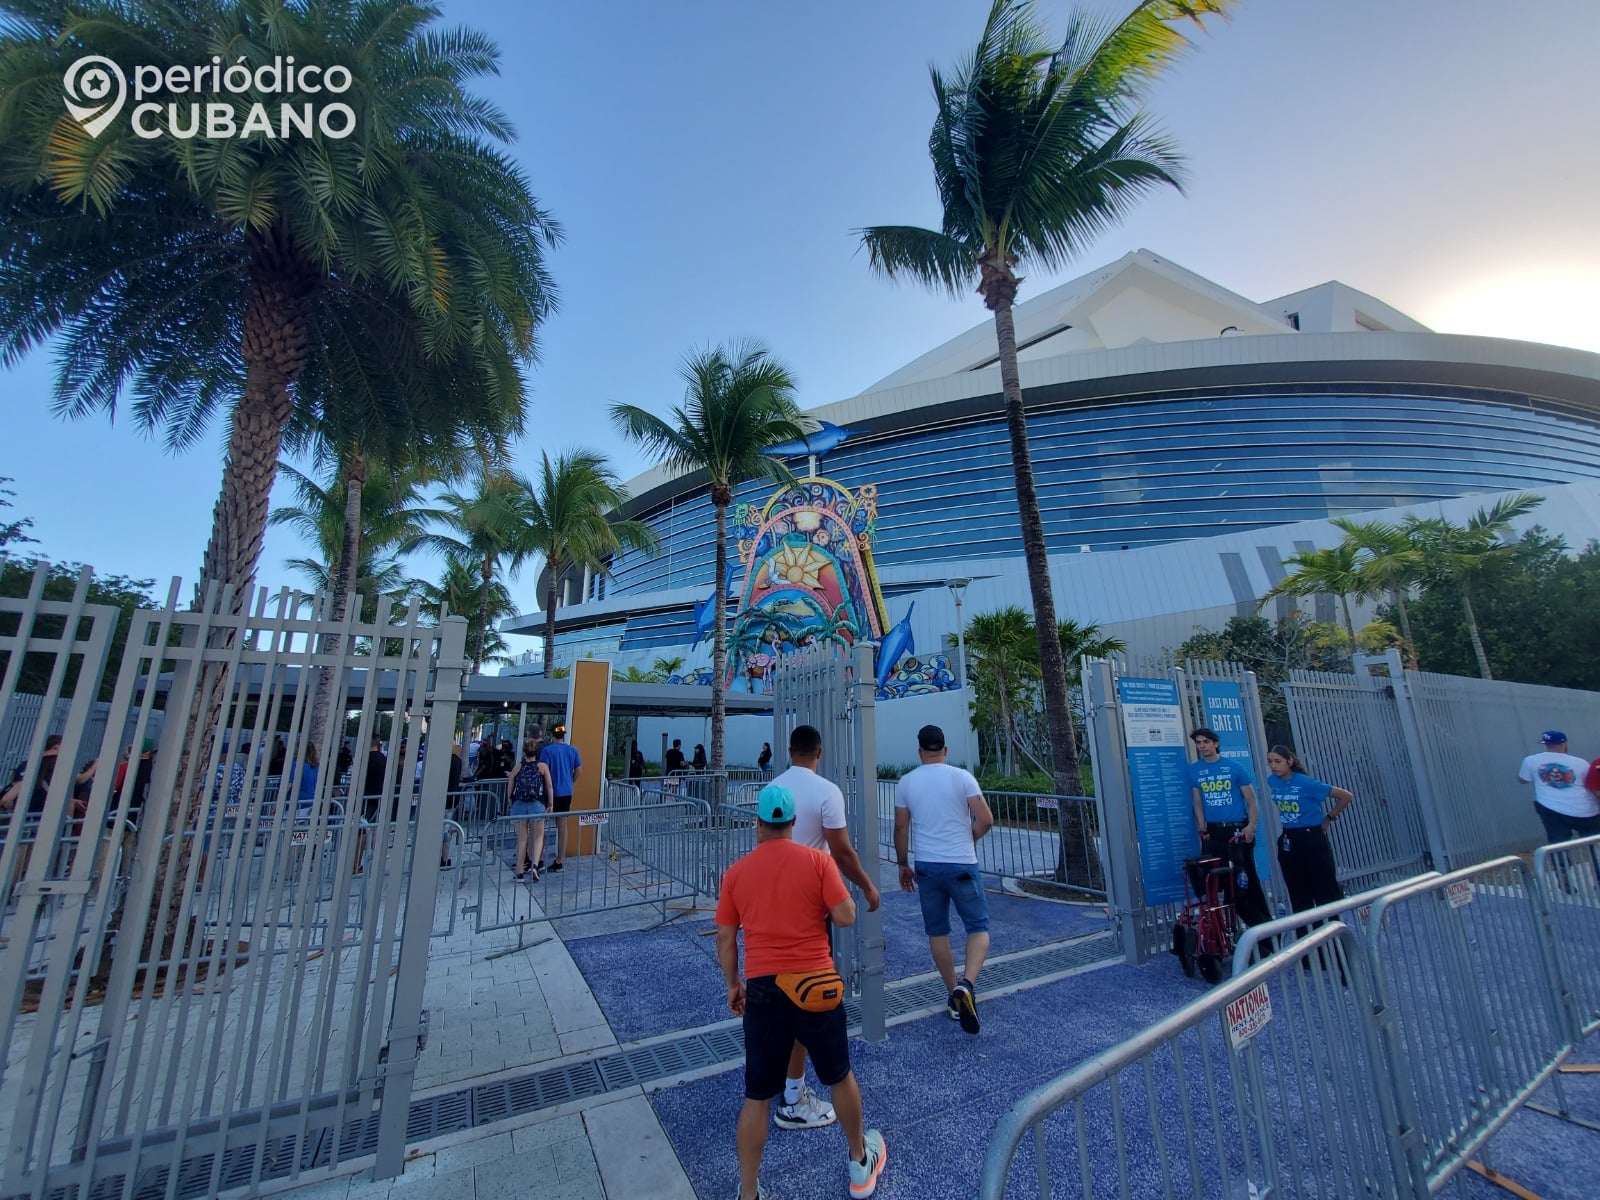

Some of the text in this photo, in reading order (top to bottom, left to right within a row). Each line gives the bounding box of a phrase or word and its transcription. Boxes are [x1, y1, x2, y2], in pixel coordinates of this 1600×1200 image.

[1208, 697, 1240, 709] EAST PLAZA
[1212, 714, 1243, 732] GATE 11
[1201, 780, 1232, 792] BOGO
[1278, 800, 1300, 813] OGO
[1227, 984, 1269, 1027] NATIONAL
